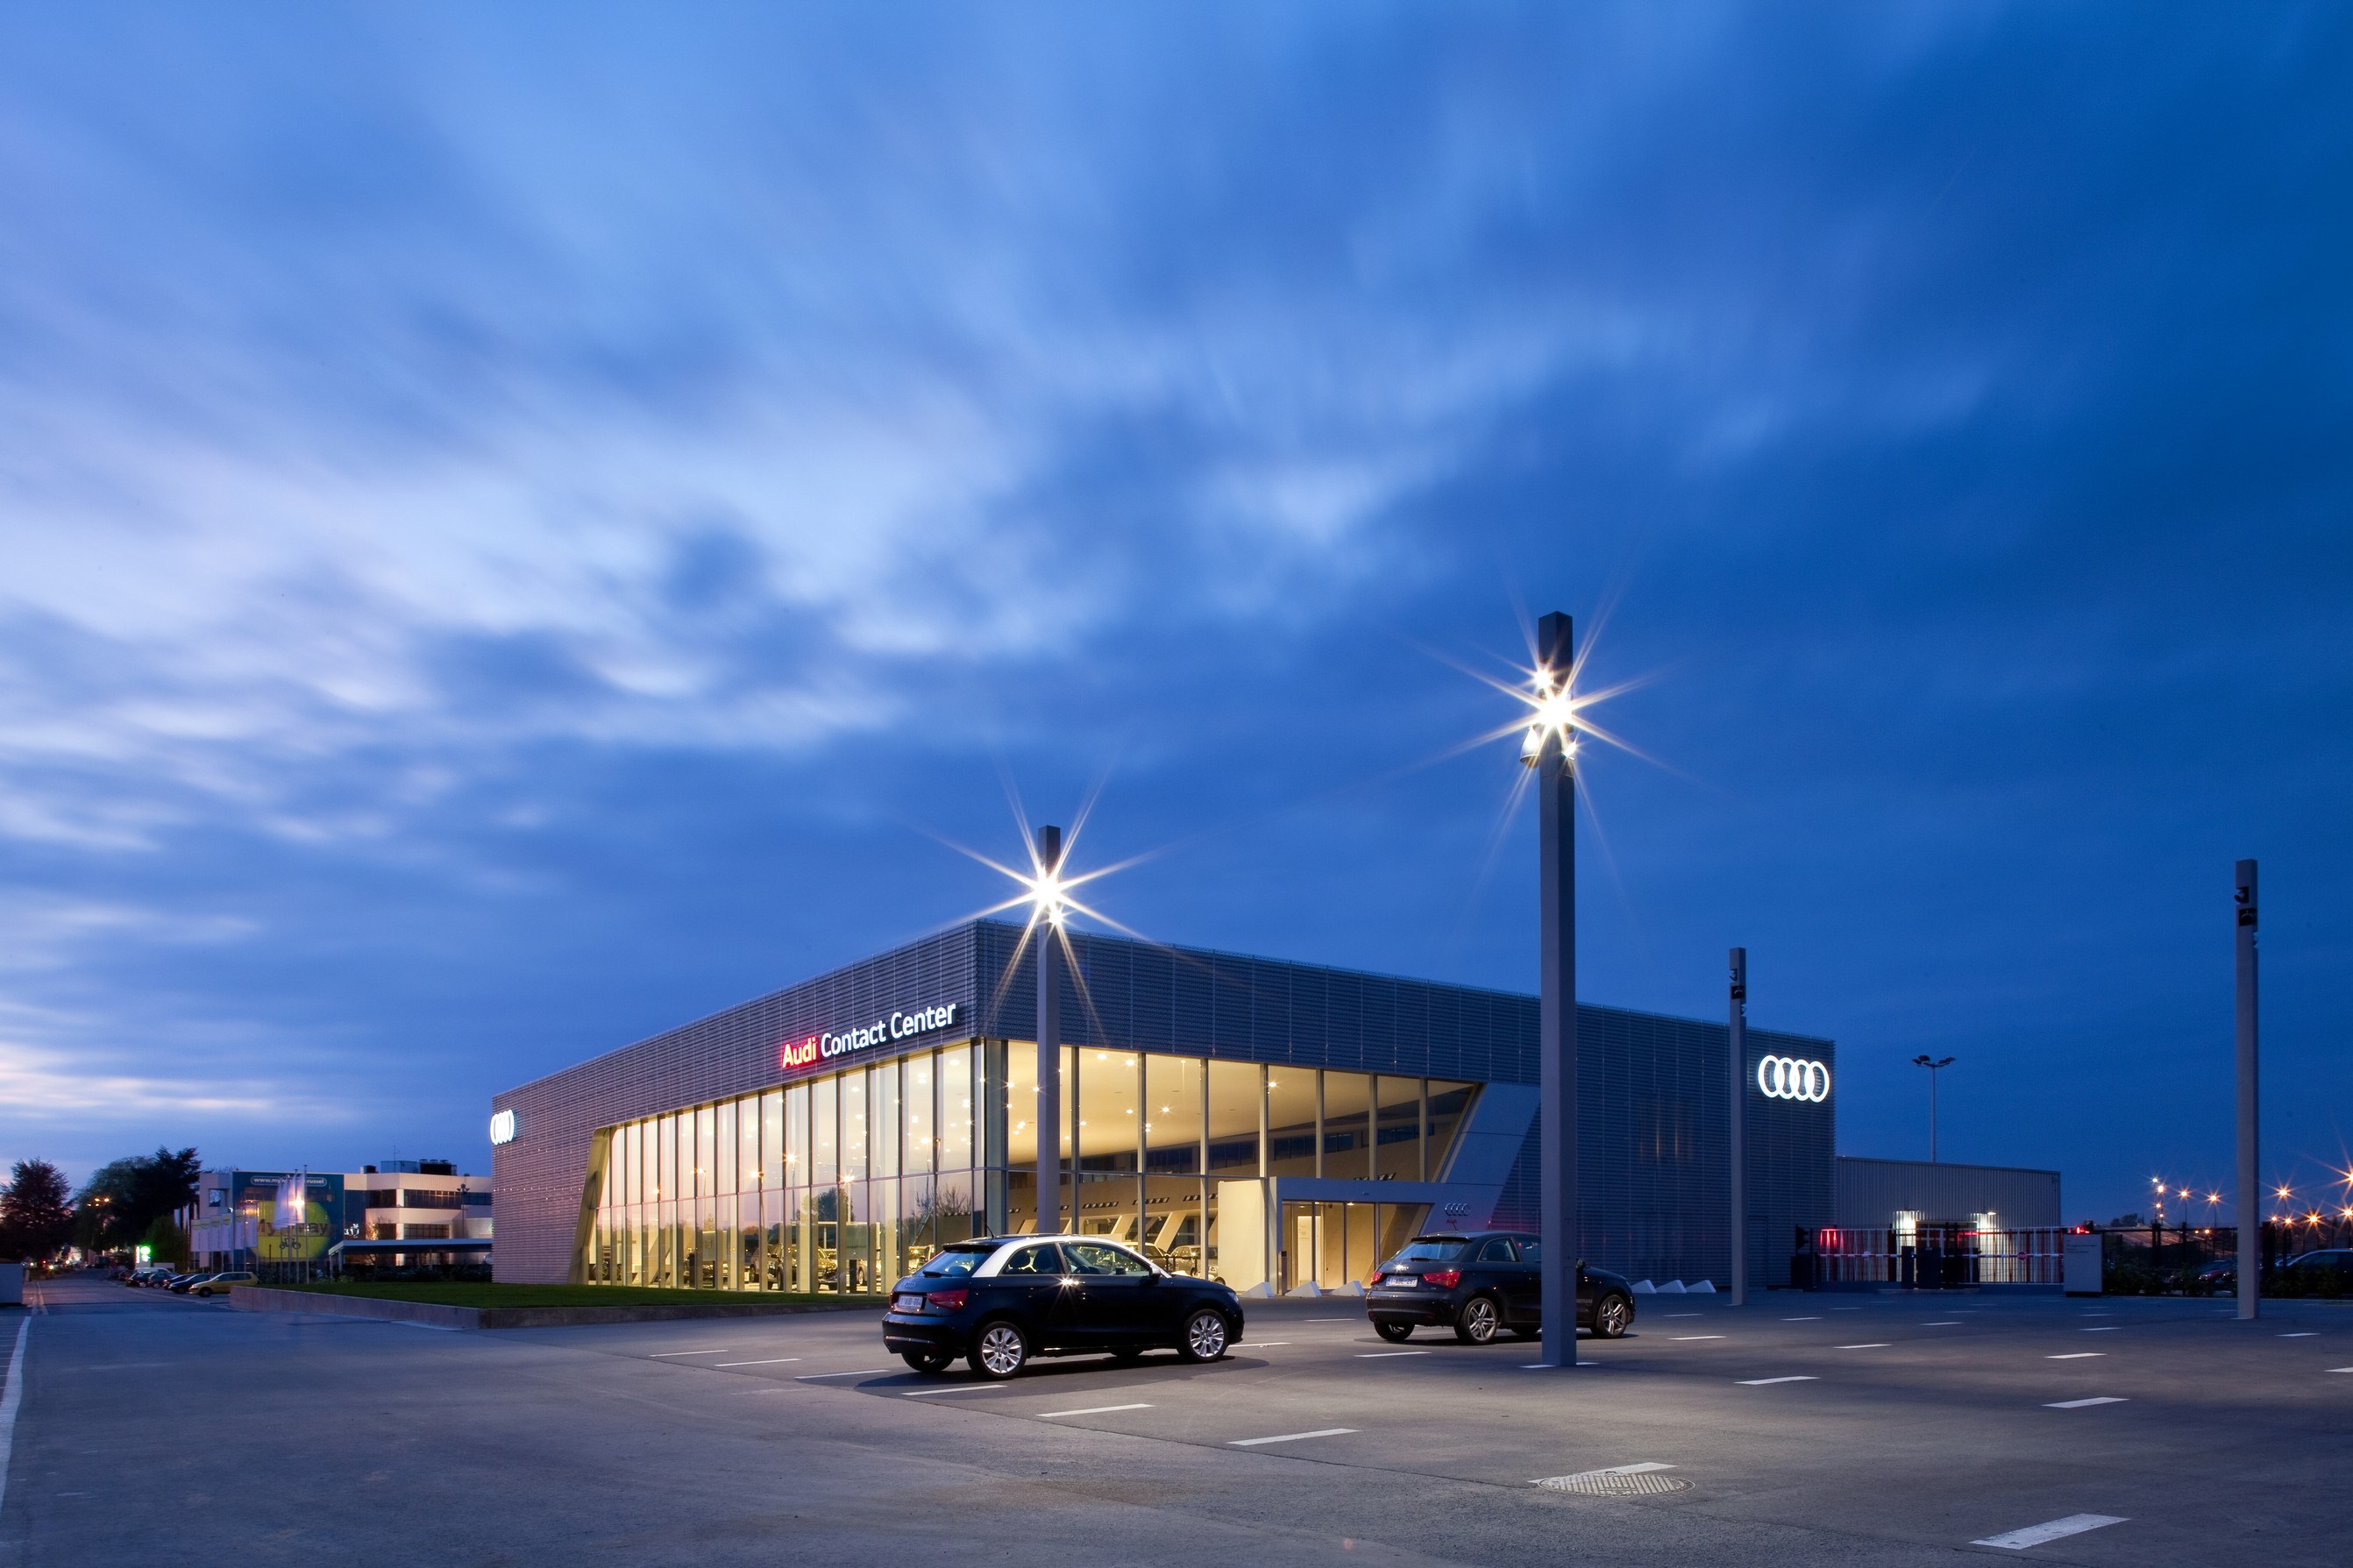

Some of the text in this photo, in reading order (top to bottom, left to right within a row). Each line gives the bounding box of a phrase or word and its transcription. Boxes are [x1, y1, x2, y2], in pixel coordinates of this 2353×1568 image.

[782, 1003, 956, 1068] Audi Contact Center
